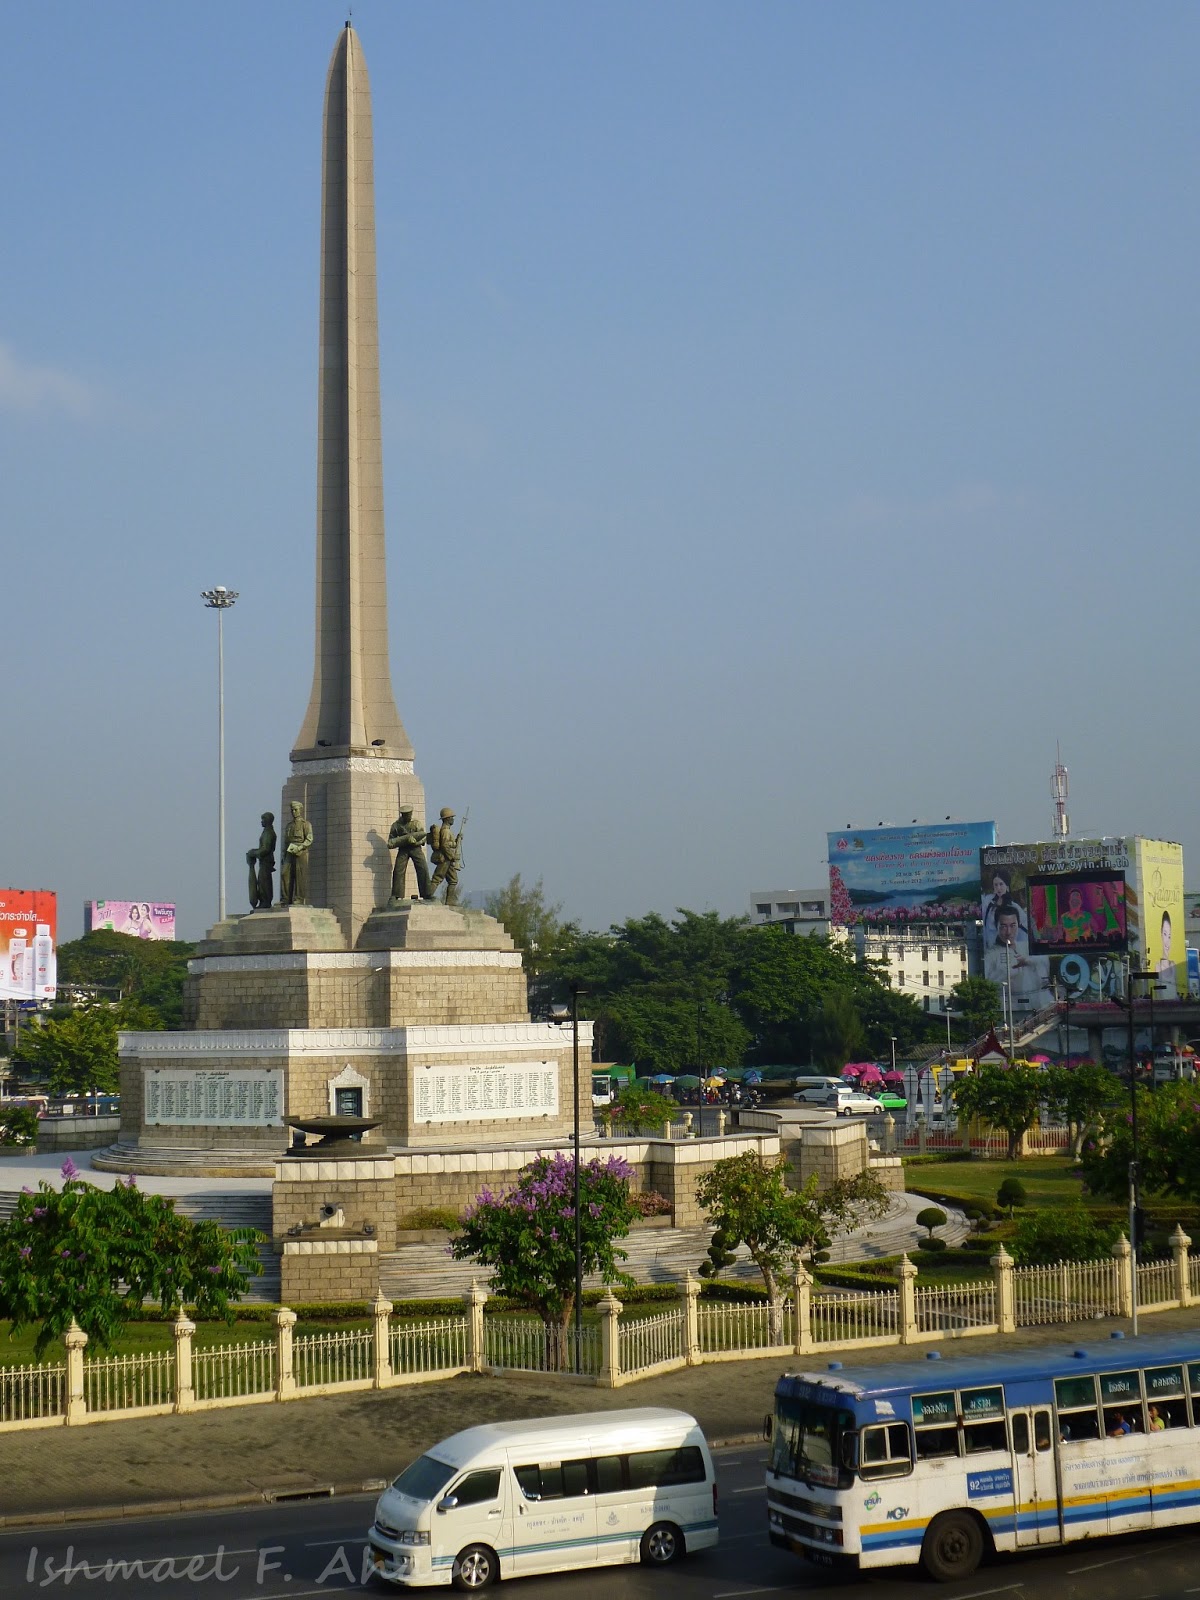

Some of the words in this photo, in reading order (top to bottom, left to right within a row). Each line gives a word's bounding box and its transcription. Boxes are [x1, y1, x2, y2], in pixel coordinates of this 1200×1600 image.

[1038, 858, 1130, 872] www.9yin.in.th
[969, 1480, 980, 1491] 92
[886, 1506, 910, 1521] NGV
